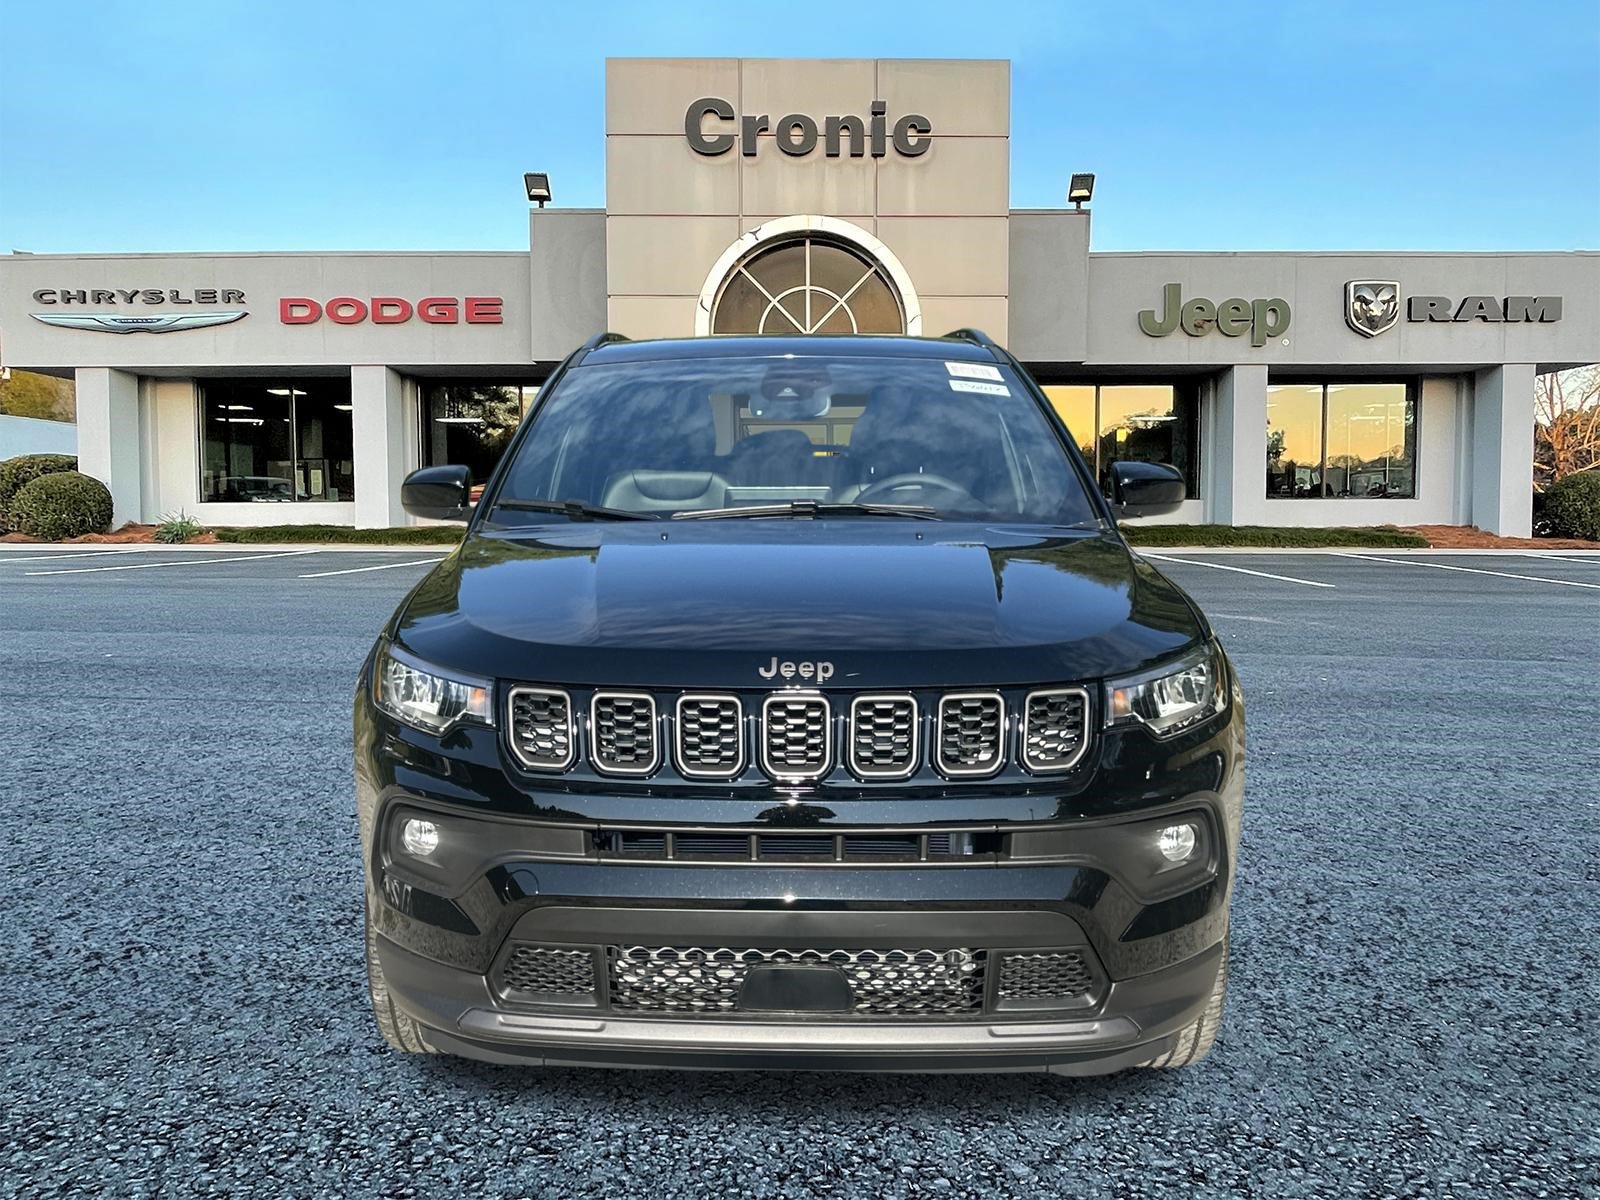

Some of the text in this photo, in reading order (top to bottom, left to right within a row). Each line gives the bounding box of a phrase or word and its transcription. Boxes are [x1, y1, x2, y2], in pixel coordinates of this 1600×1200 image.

[684, 97, 932, 157] Cronic
[32, 288, 246, 305] CHRYSLER
[280, 296, 504, 325] DODGE
[1407, 295, 1563, 323] RAM
[1138, 283, 1292, 347] Jeep
[758, 656, 835, 685] Jeep
